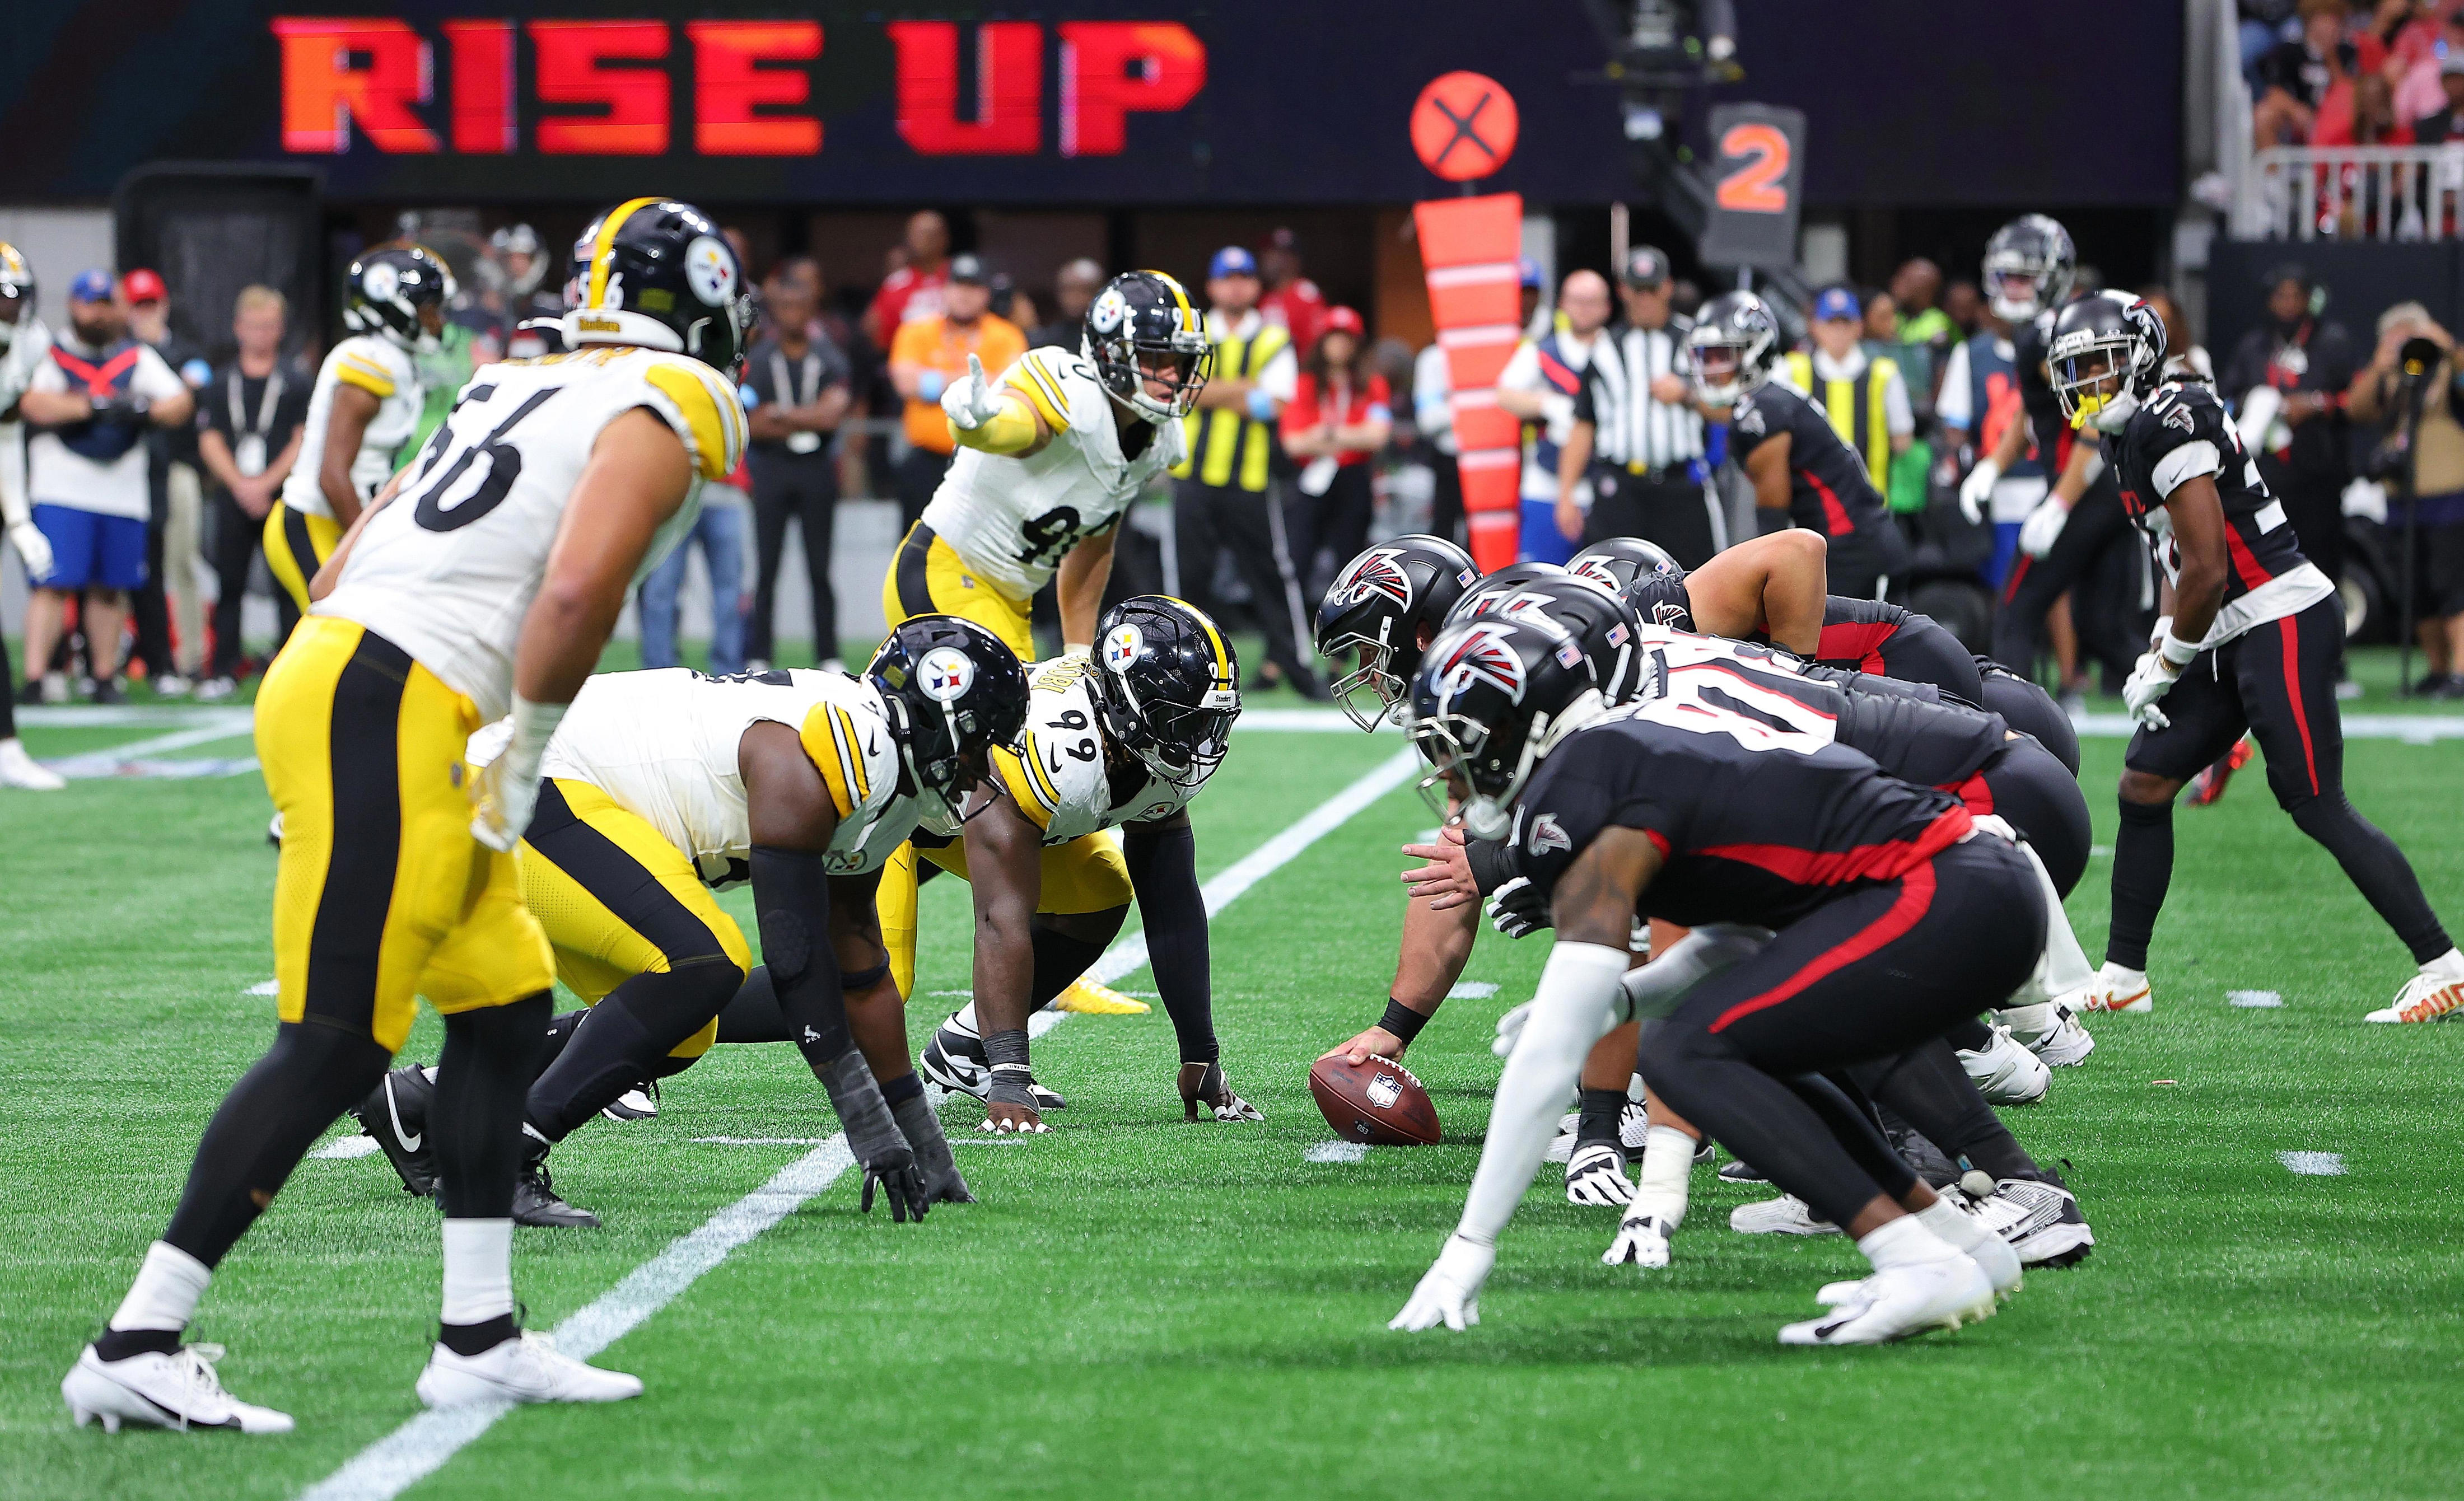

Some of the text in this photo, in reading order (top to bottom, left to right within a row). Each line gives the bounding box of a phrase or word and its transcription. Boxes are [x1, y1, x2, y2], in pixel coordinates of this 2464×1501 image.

[269, 16, 1208, 158] RISE UP
[1718, 124, 1790, 212] 2
[1207, 662, 1235, 690] 99
[1045, 710, 1096, 762] 99
[1357, 1124, 1369, 1135] 053
